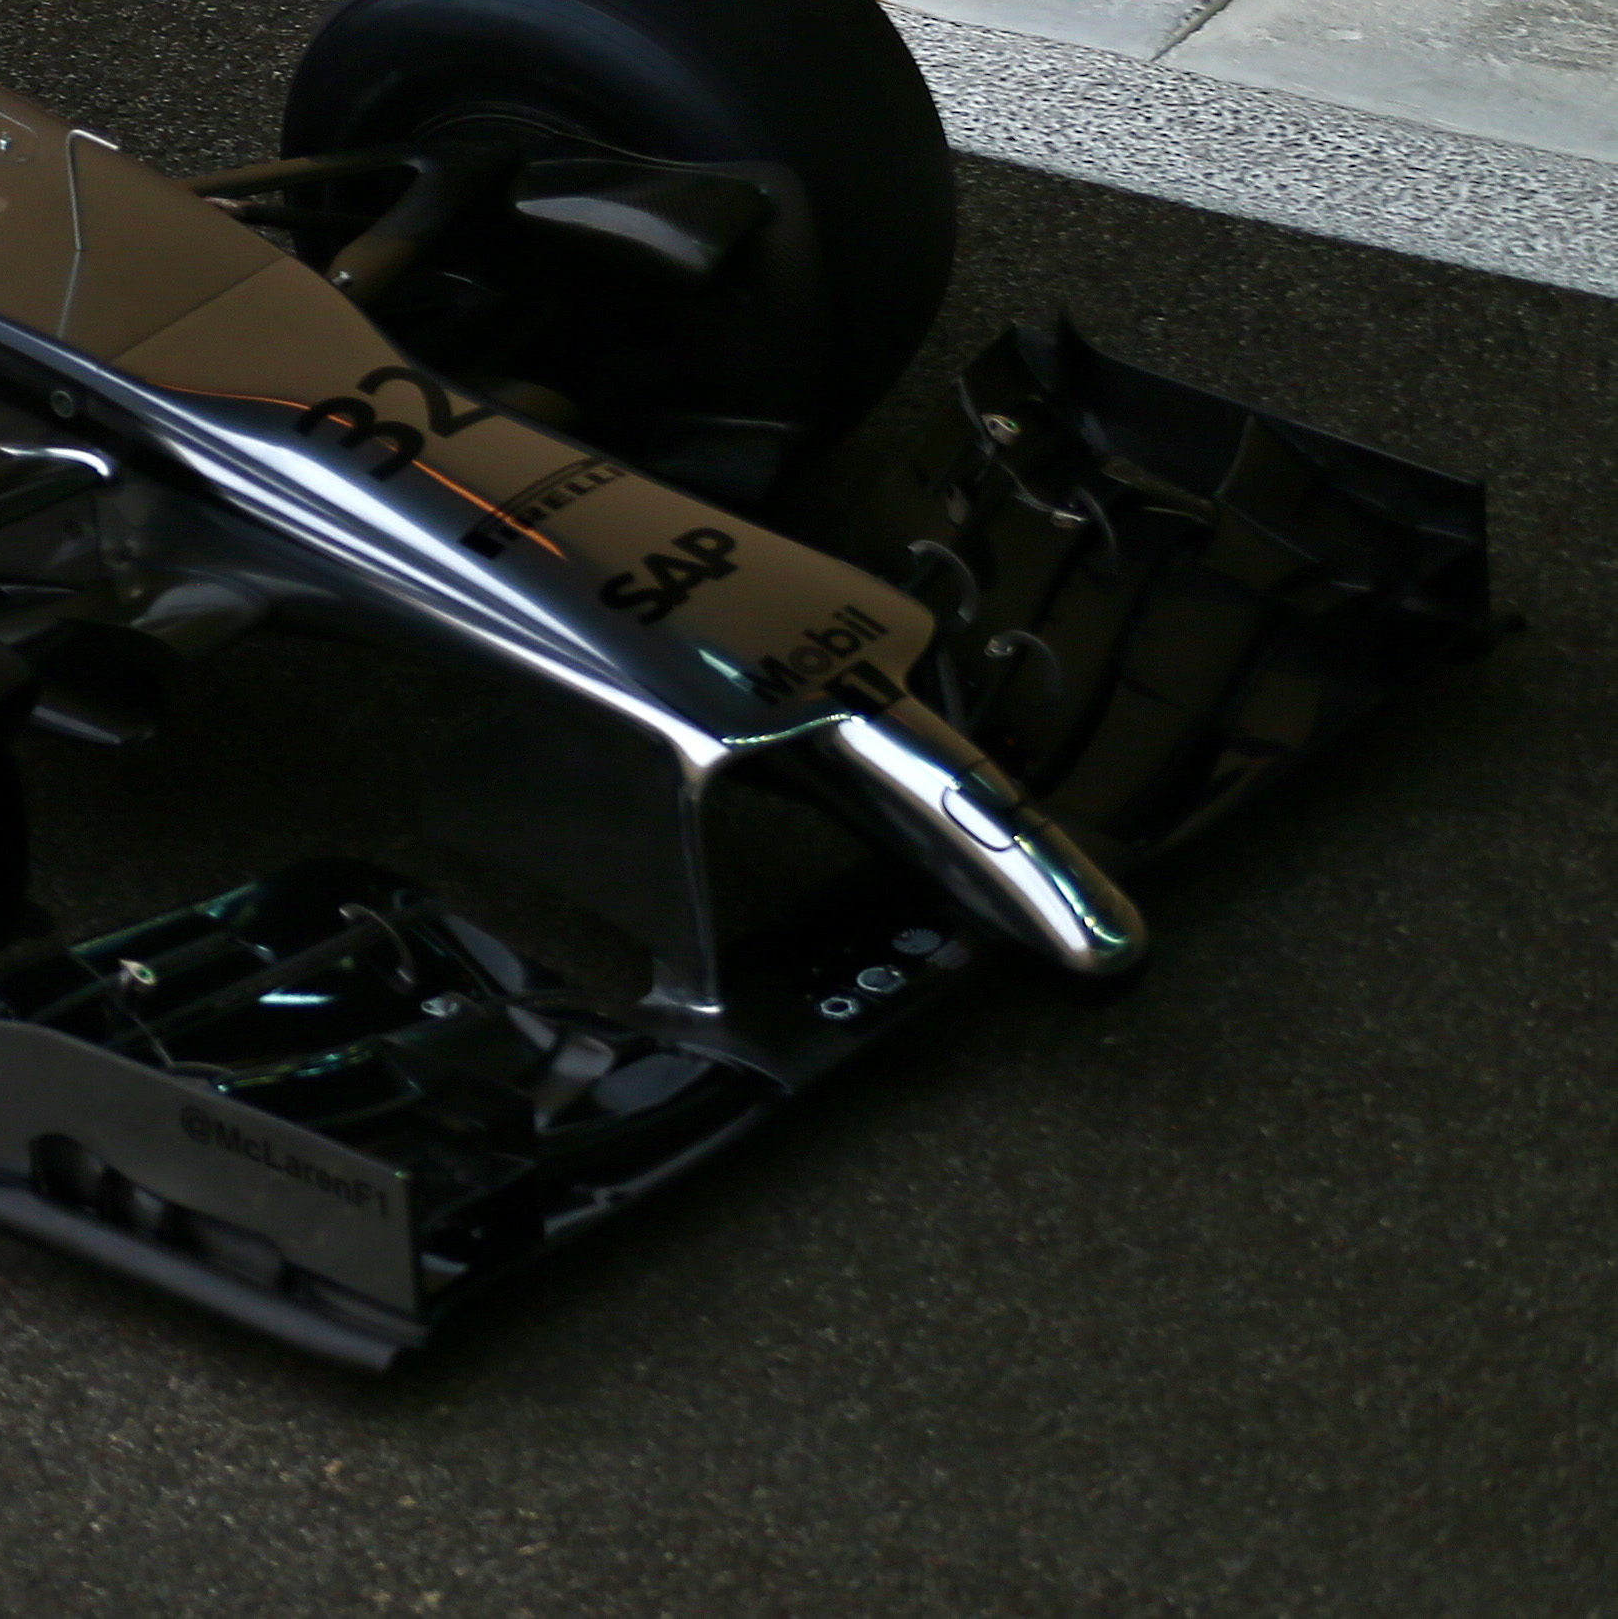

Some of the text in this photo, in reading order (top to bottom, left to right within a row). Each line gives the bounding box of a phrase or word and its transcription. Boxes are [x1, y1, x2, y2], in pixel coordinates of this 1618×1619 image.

[293, 365, 498, 482] 32
[461, 456, 628, 559] PIRELLI
[598, 526, 738, 626] SAP
[746, 603, 890, 706] Mobil
[180, 1104, 390, 1218] @McLarenF1
